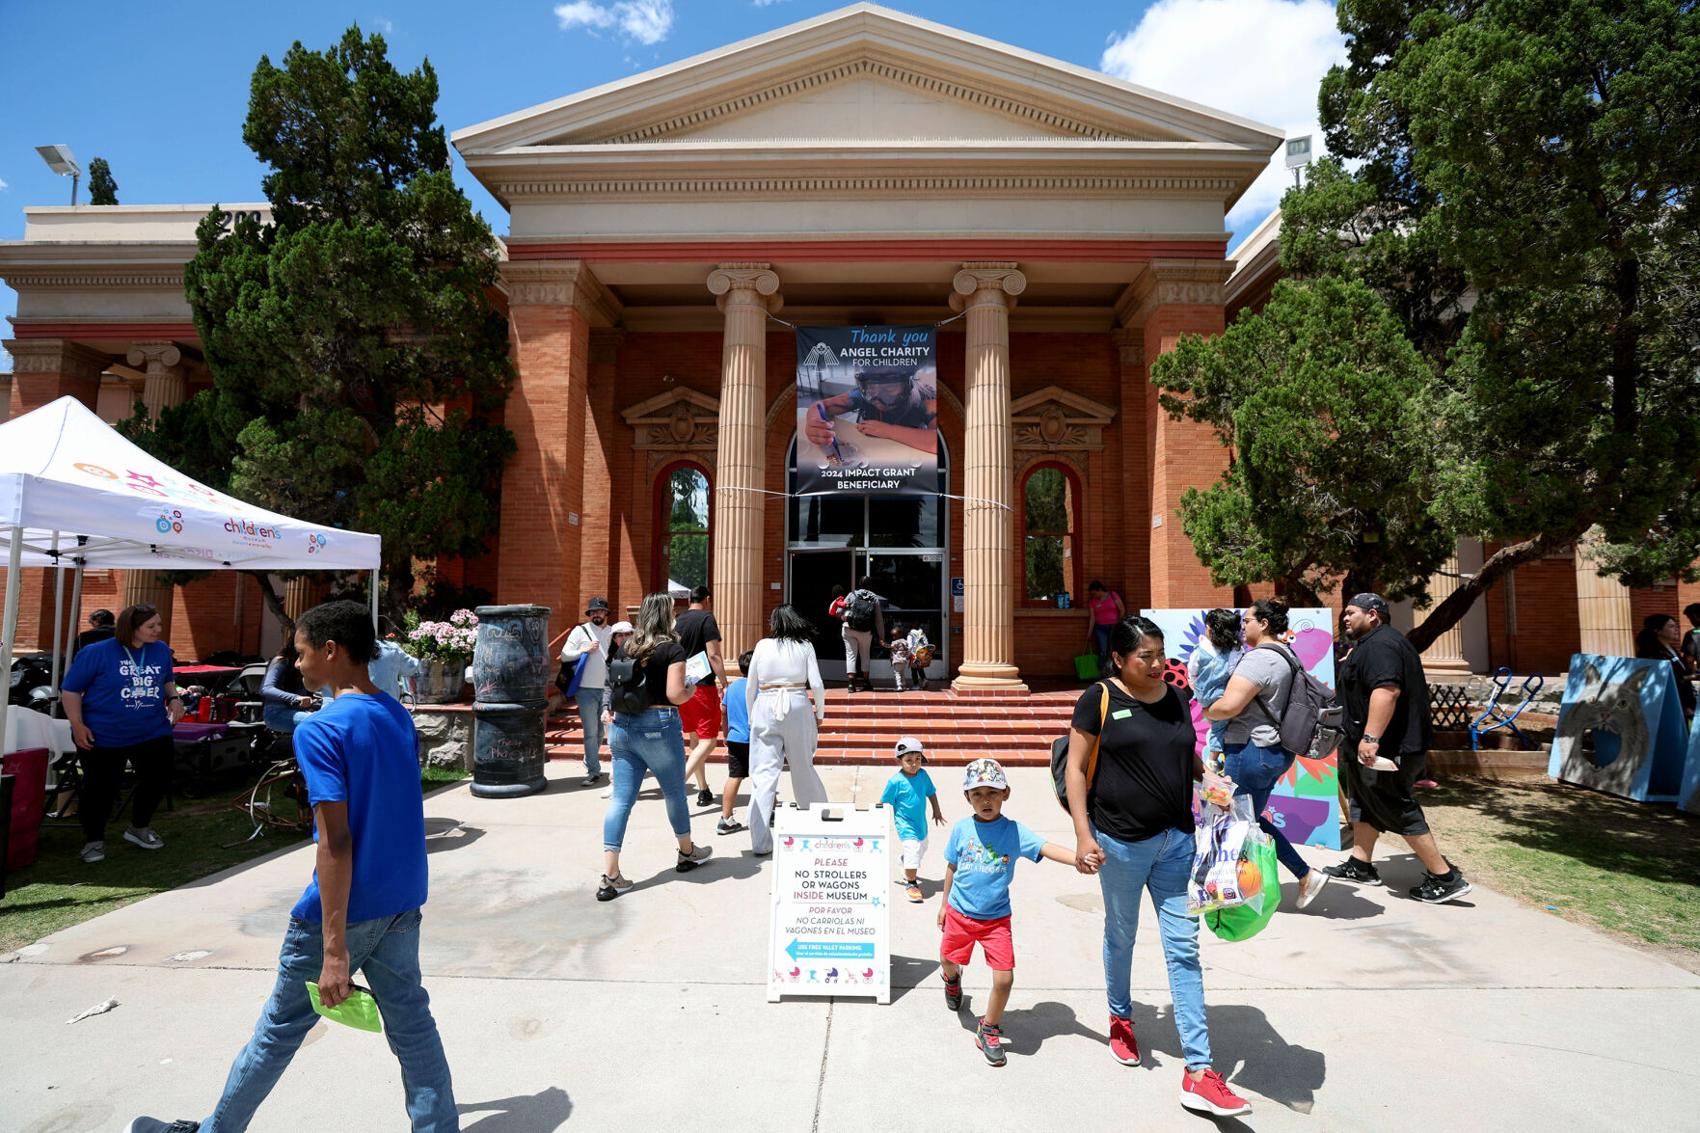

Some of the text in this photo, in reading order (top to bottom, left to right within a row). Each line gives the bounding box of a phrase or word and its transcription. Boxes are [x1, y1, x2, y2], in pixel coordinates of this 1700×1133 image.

[851, 328, 929, 347] Thank you
[840, 346, 930, 357] ANGEL CHARITY
[852, 358, 918, 367] FOR CHILDREN
[821, 468, 916, 478] 2024 IMPACT GRANT
[837, 480, 900, 489] BENEFICIARY
[132, 675, 153, 687] BIG
[814, 857, 849, 867] PLEASE
[794, 870, 867, 879] NO STROLLERS
[801, 880, 860, 890] OR WAGONS
[793, 891, 868, 900] INSIDE MUSEUM
[808, 906, 853, 914] POR FAVOR
[796, 917, 809, 925] NO
[810, 917, 855, 925] CARRIOLAS
[785, 926, 876, 935] VAGONES EN EL MUSEO
